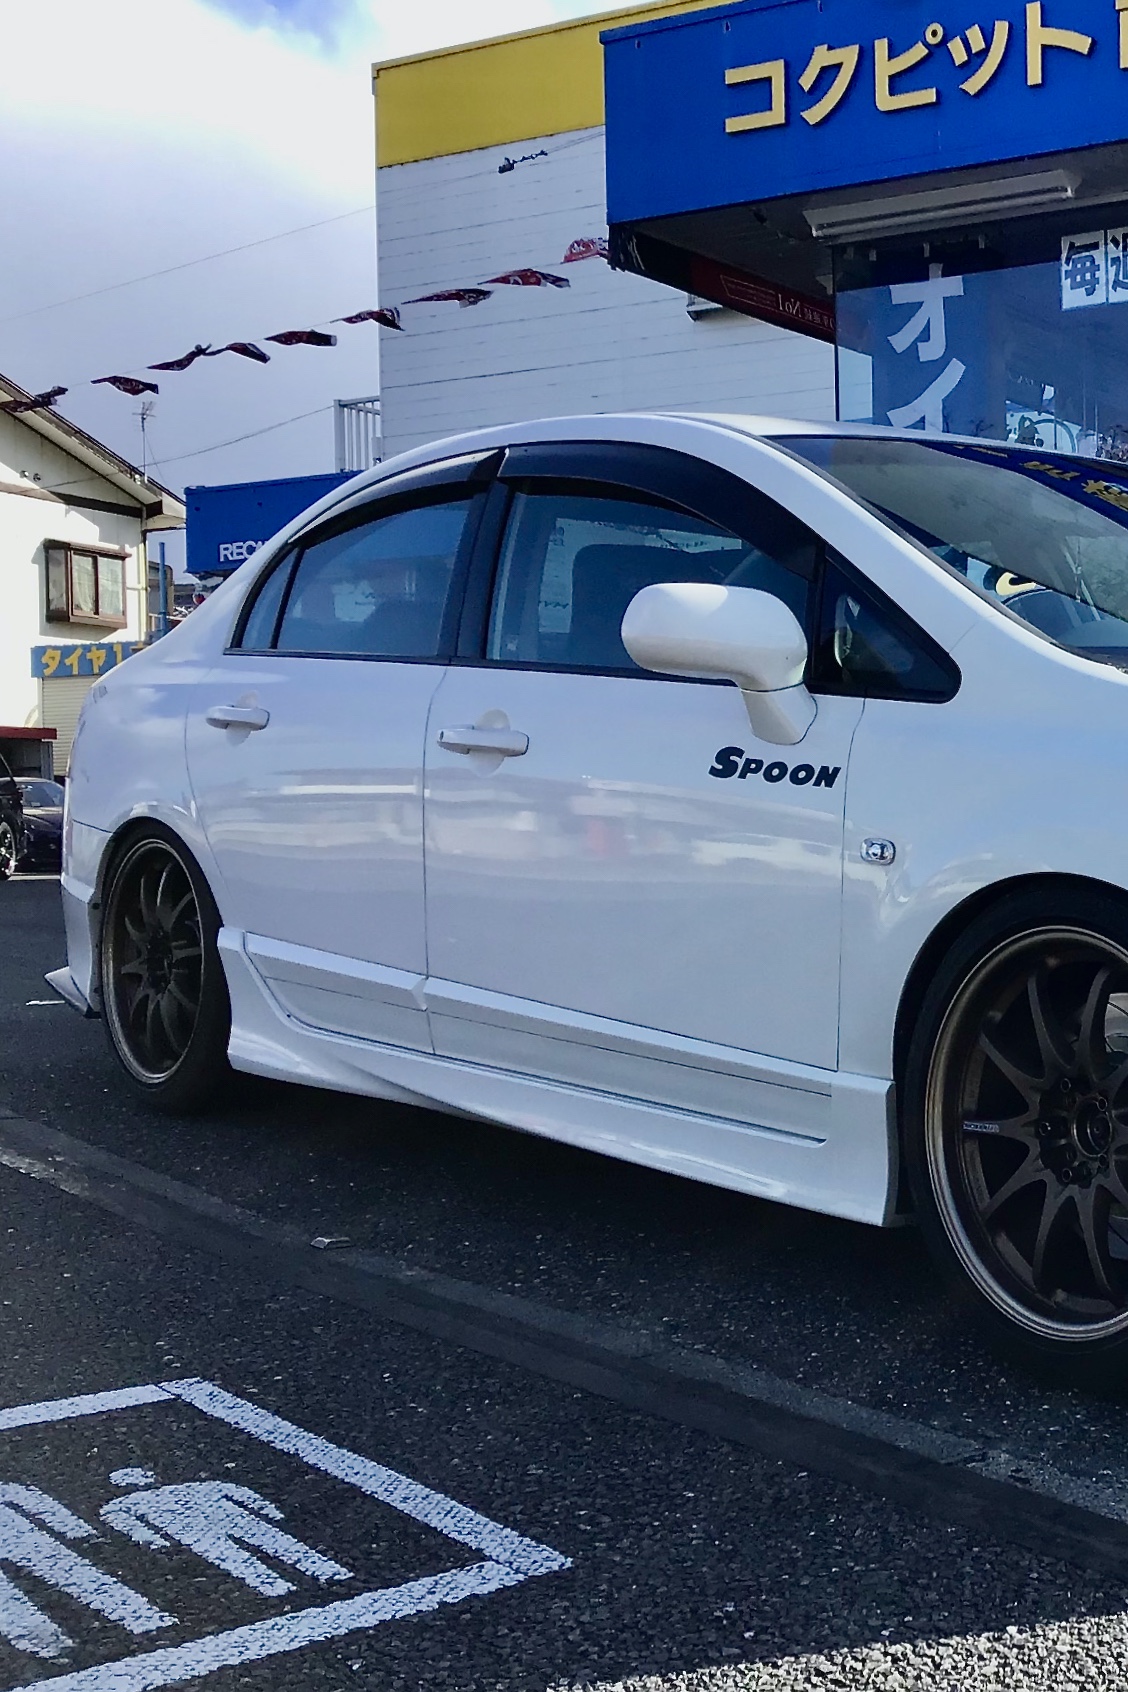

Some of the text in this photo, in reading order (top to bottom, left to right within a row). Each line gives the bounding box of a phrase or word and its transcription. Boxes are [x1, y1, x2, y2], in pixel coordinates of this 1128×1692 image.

[724, 1, 1093, 133] コクピット
[219, 540, 269, 563] REC
[41, 642, 144, 677] タイヤ1
